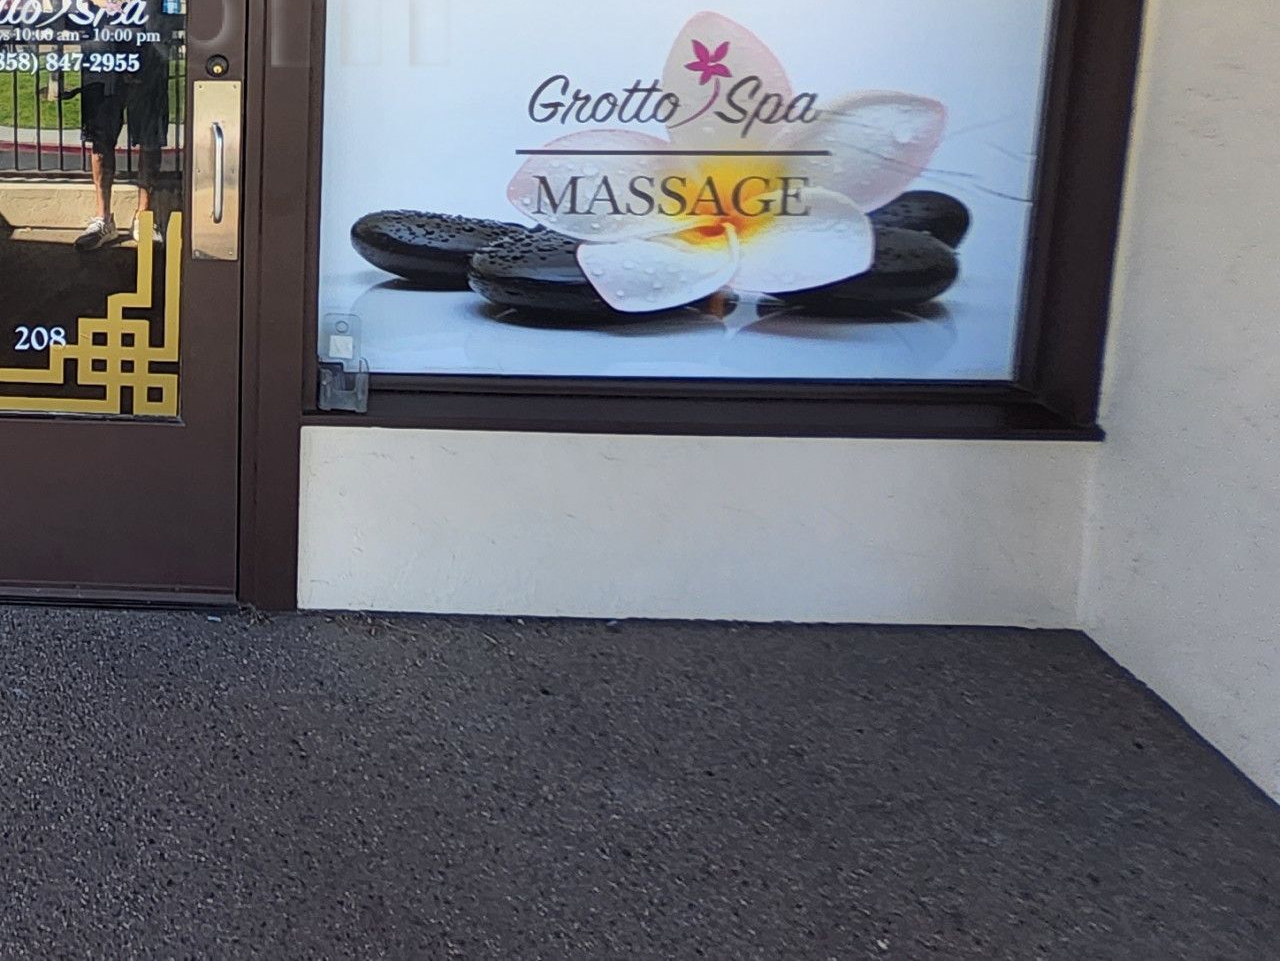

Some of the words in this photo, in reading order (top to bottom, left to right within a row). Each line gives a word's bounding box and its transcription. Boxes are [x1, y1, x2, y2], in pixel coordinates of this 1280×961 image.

[14, 28, 53, 42] 10:00
[56, 30, 80, 42] am
[93, 28, 132, 42] 10:00
[136, 32, 161, 46] pm
[45, 53, 140, 72] 847-2955
[528, 74, 680, 124] Grotto
[714, 75, 819, 137] Spa
[532, 176, 811, 217] MASSAGE
[14, 326, 67, 350] 208
